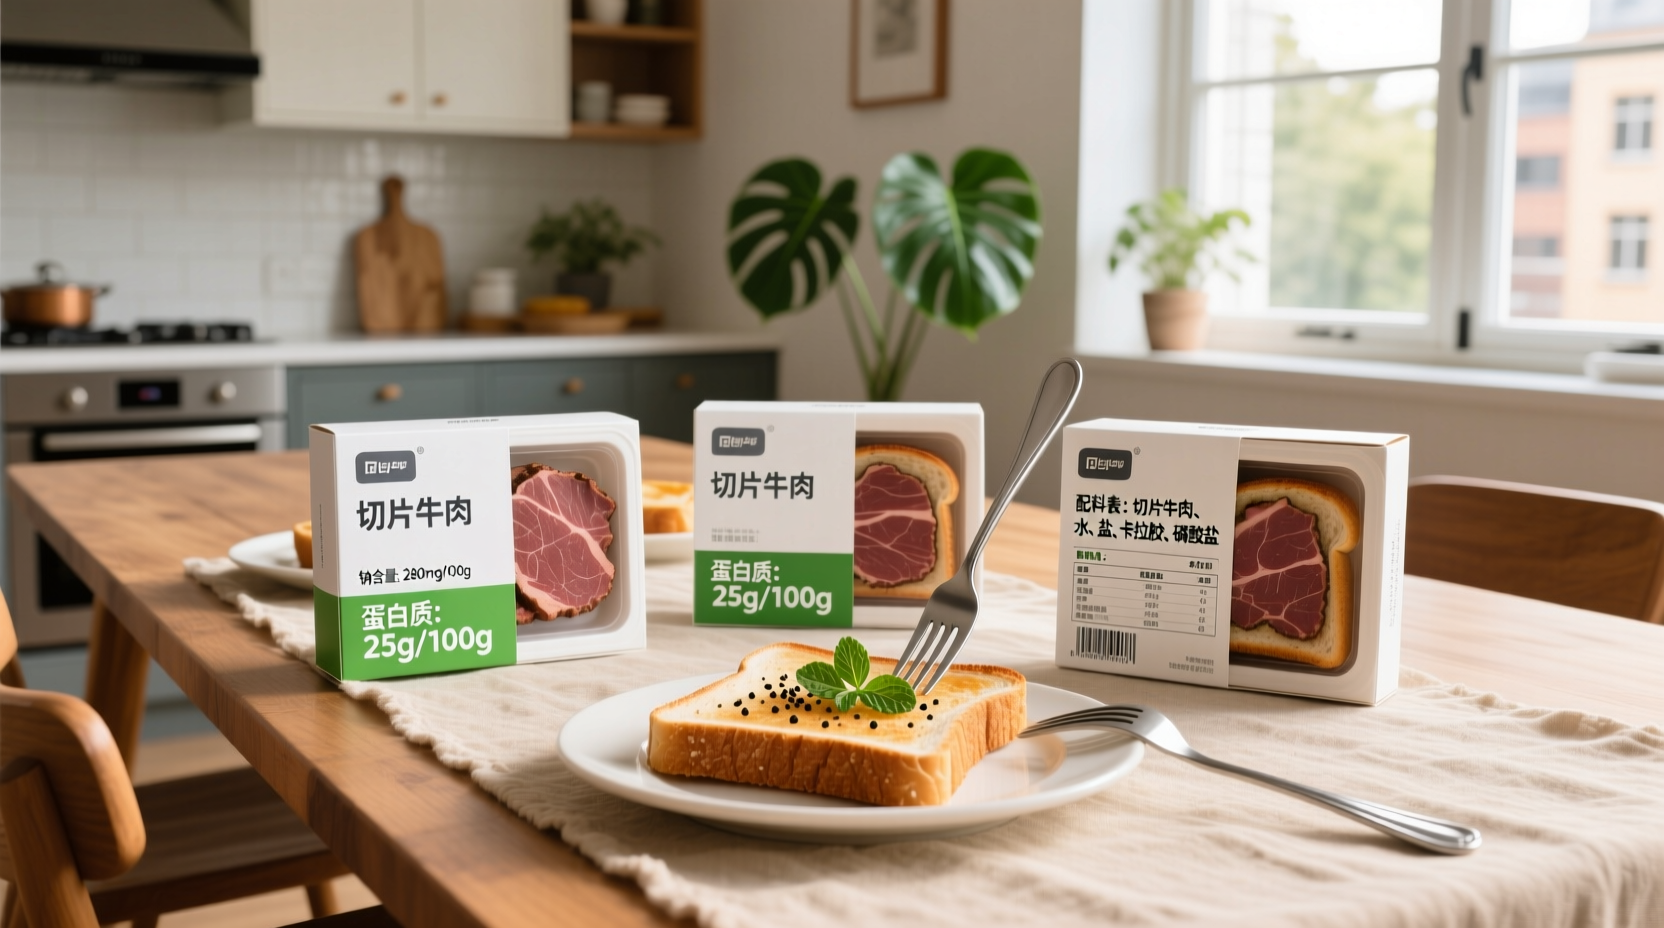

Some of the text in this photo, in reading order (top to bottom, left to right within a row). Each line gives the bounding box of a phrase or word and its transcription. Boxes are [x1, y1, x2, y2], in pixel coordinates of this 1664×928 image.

[710, 471, 814, 499] 切片牛肉
[356, 495, 472, 531] 切片牛肉
[711, 584, 833, 616] 25g/100g
[363, 626, 493, 664] 25g/100g
